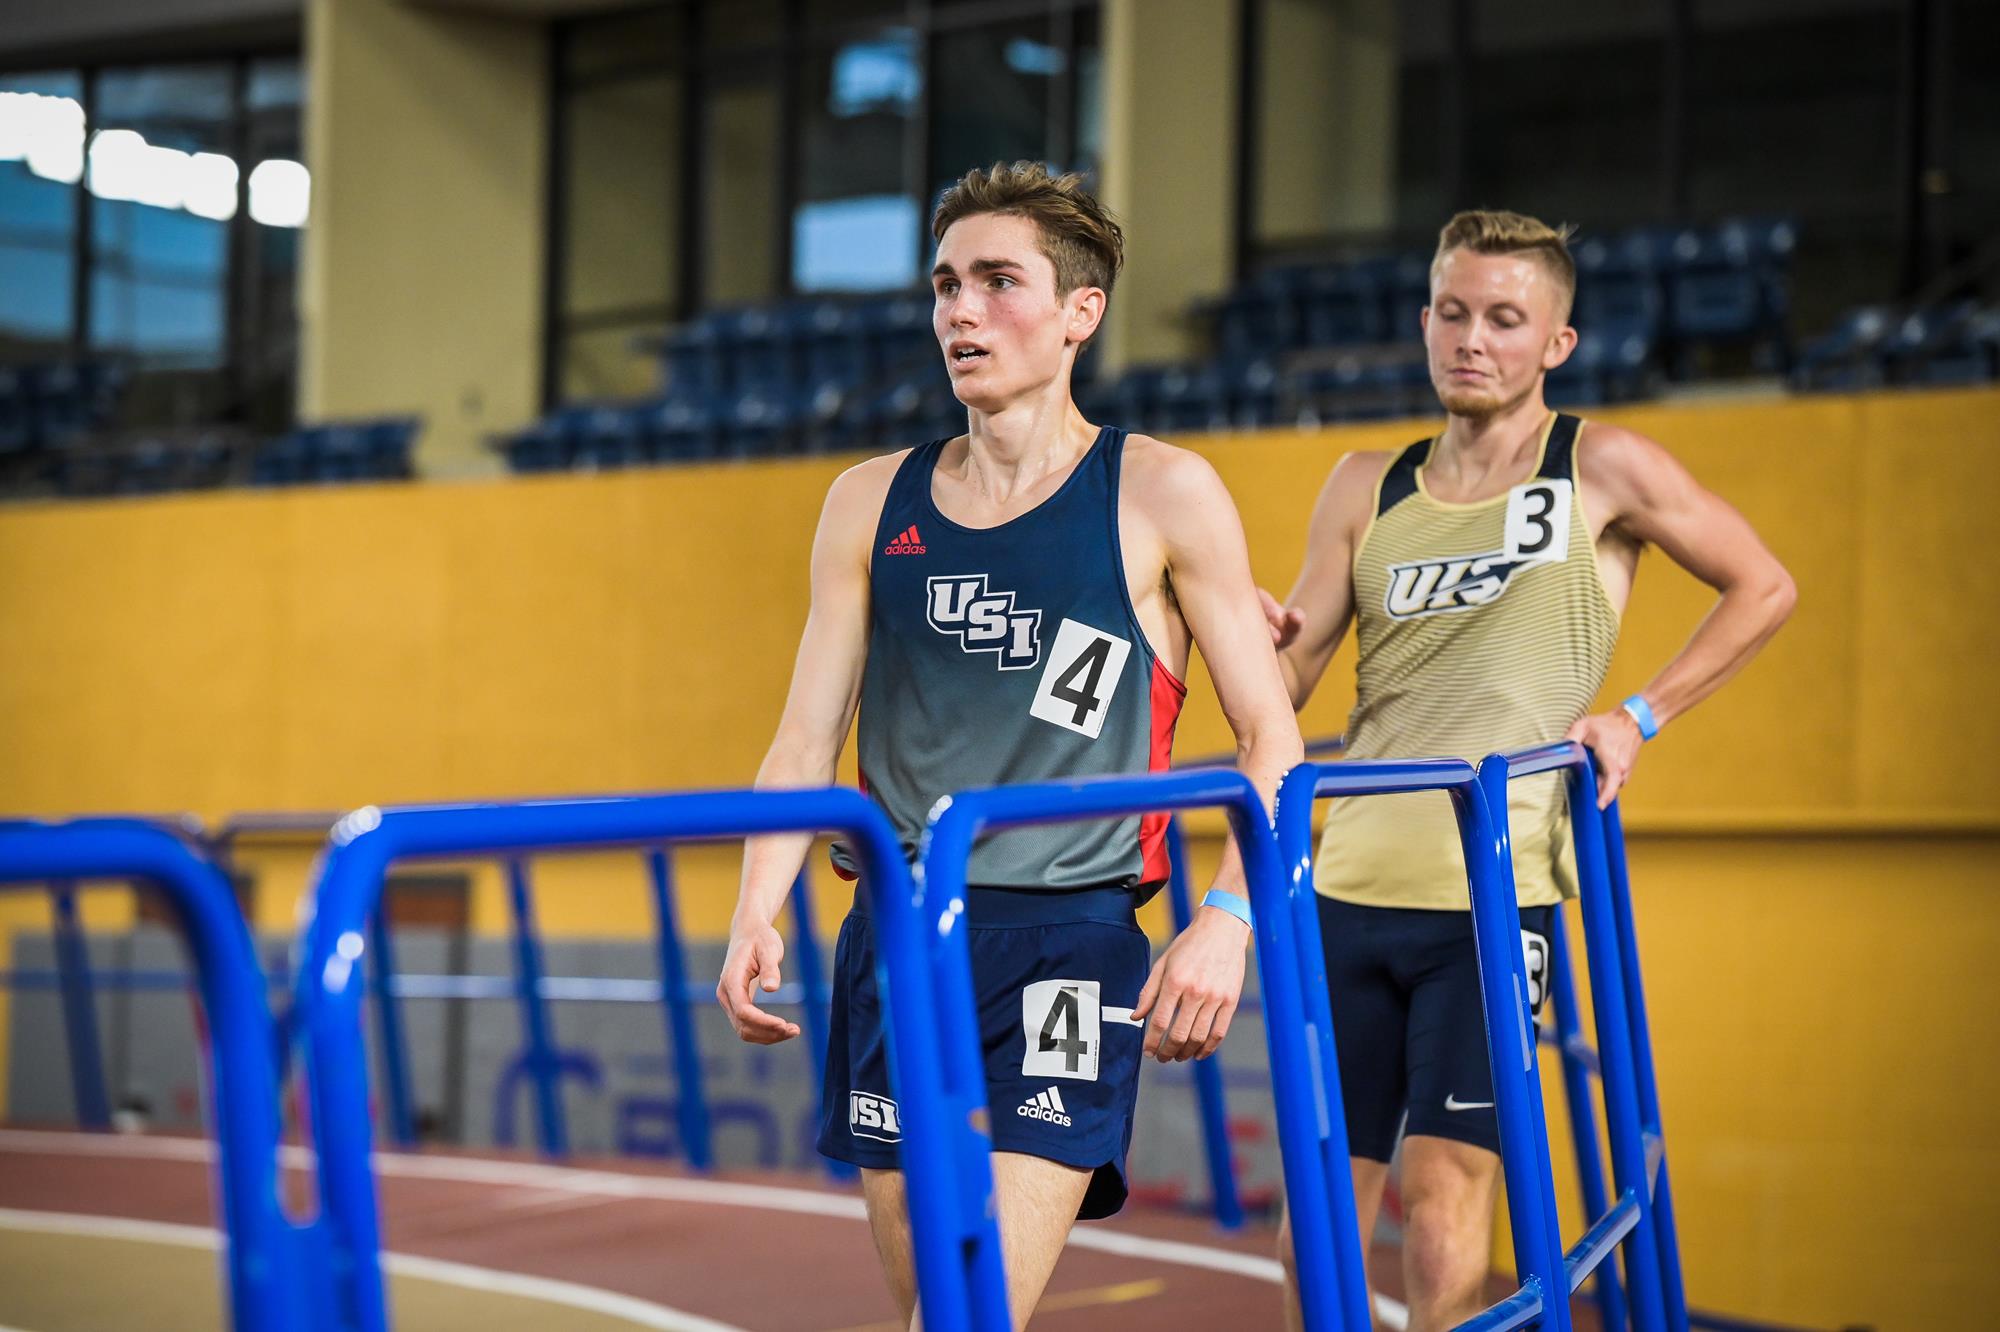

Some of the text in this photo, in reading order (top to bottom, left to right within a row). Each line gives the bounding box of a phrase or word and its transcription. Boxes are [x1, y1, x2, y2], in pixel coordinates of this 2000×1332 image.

[884, 543, 926, 556] adidas
[1517, 487, 1555, 554] 3
[930, 577, 1038, 663] USI
[1050, 636, 1113, 727] 4
[1038, 986, 1087, 1073] 4
[1016, 1104, 1072, 1128] adidas
